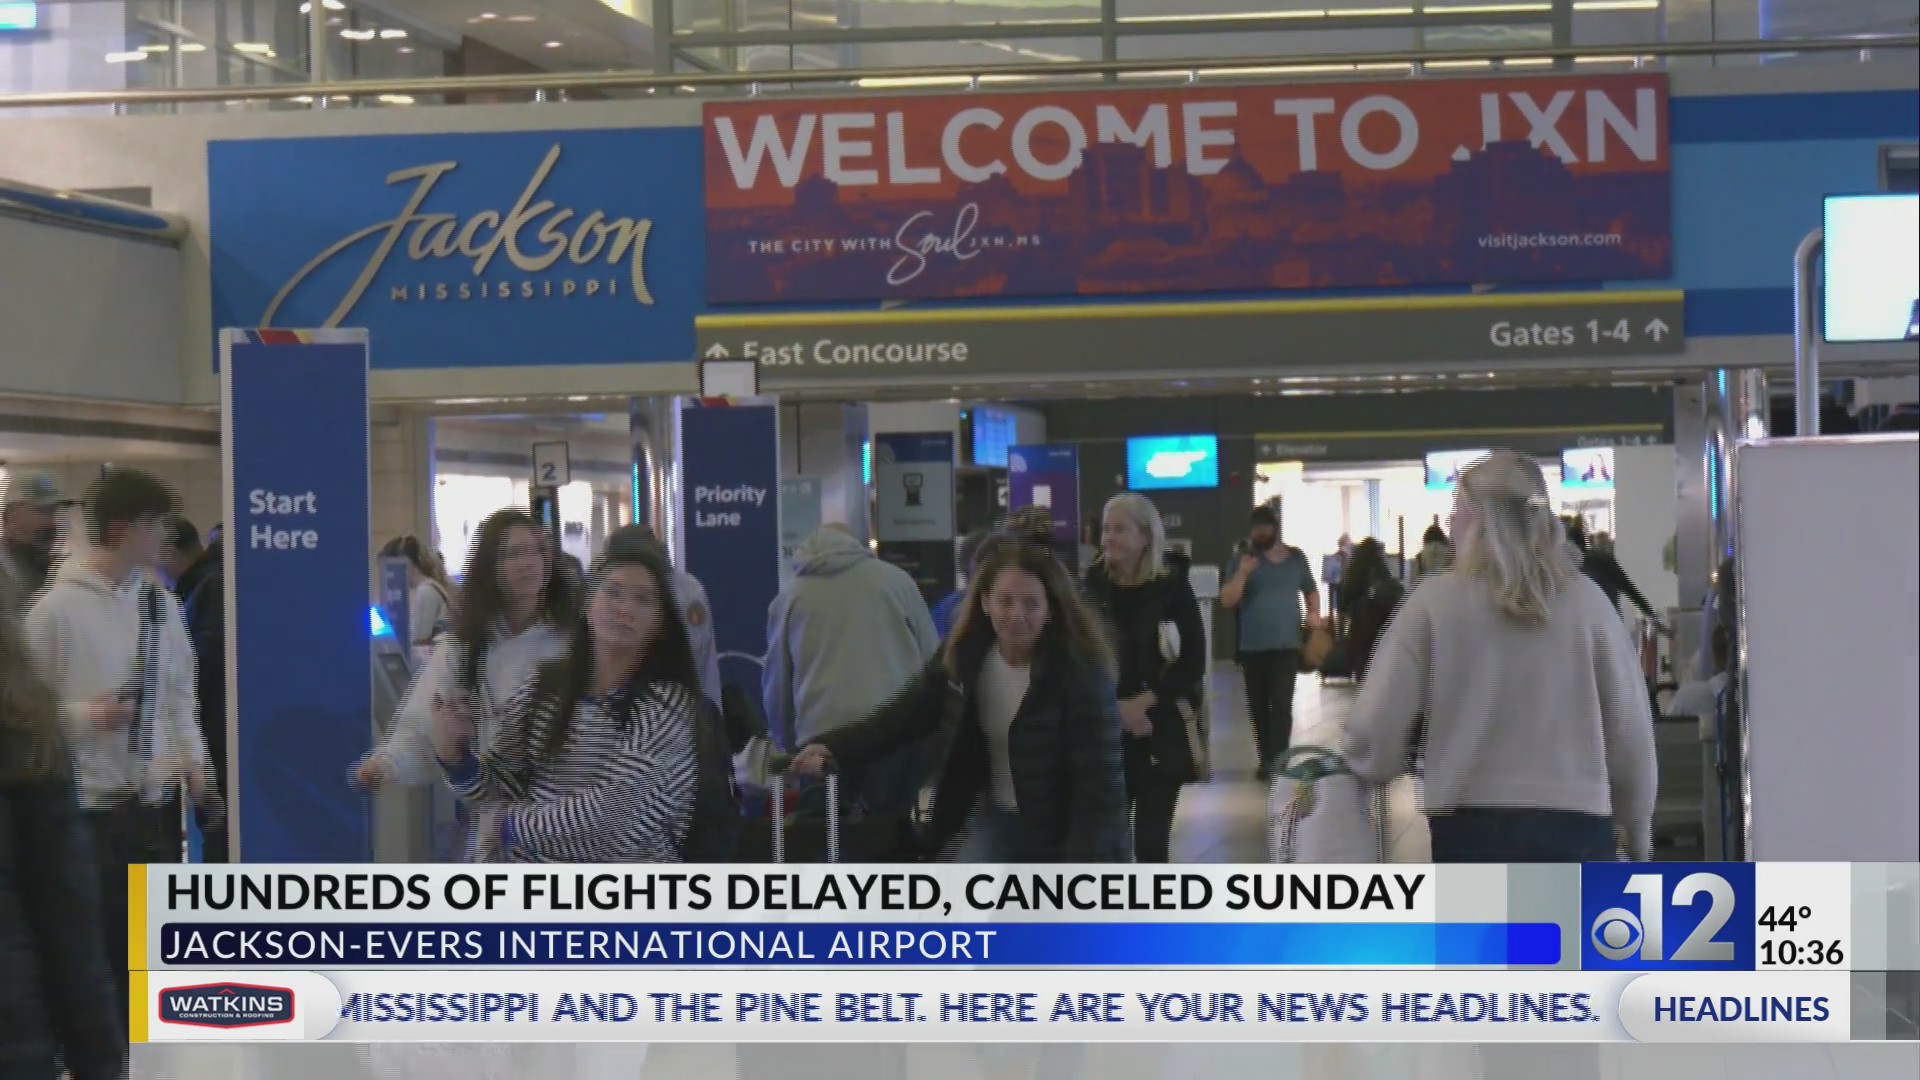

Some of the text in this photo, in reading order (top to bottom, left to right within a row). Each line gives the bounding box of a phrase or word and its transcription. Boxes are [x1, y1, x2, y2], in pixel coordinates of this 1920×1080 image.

[713, 88, 1658, 189] WELCOME TO JXN
[261, 142, 654, 329] Jackson
[748, 240, 784, 254] THE
[791, 239, 835, 252] CITY
[841, 237, 892, 251] WITH
[886, 202, 981, 286] Soul
[1478, 231, 1622, 251] visitjackson.com
[391, 279, 618, 301] MISSISSIPPI
[1489, 318, 1631, 347] Gates 1-4
[744, 339, 969, 366] East Concourse
[541, 463, 557, 481] 2
[249, 489, 317, 515] Start
[694, 485, 767, 508] Priority
[695, 511, 741, 528] Lane
[250, 524, 319, 550] Here
